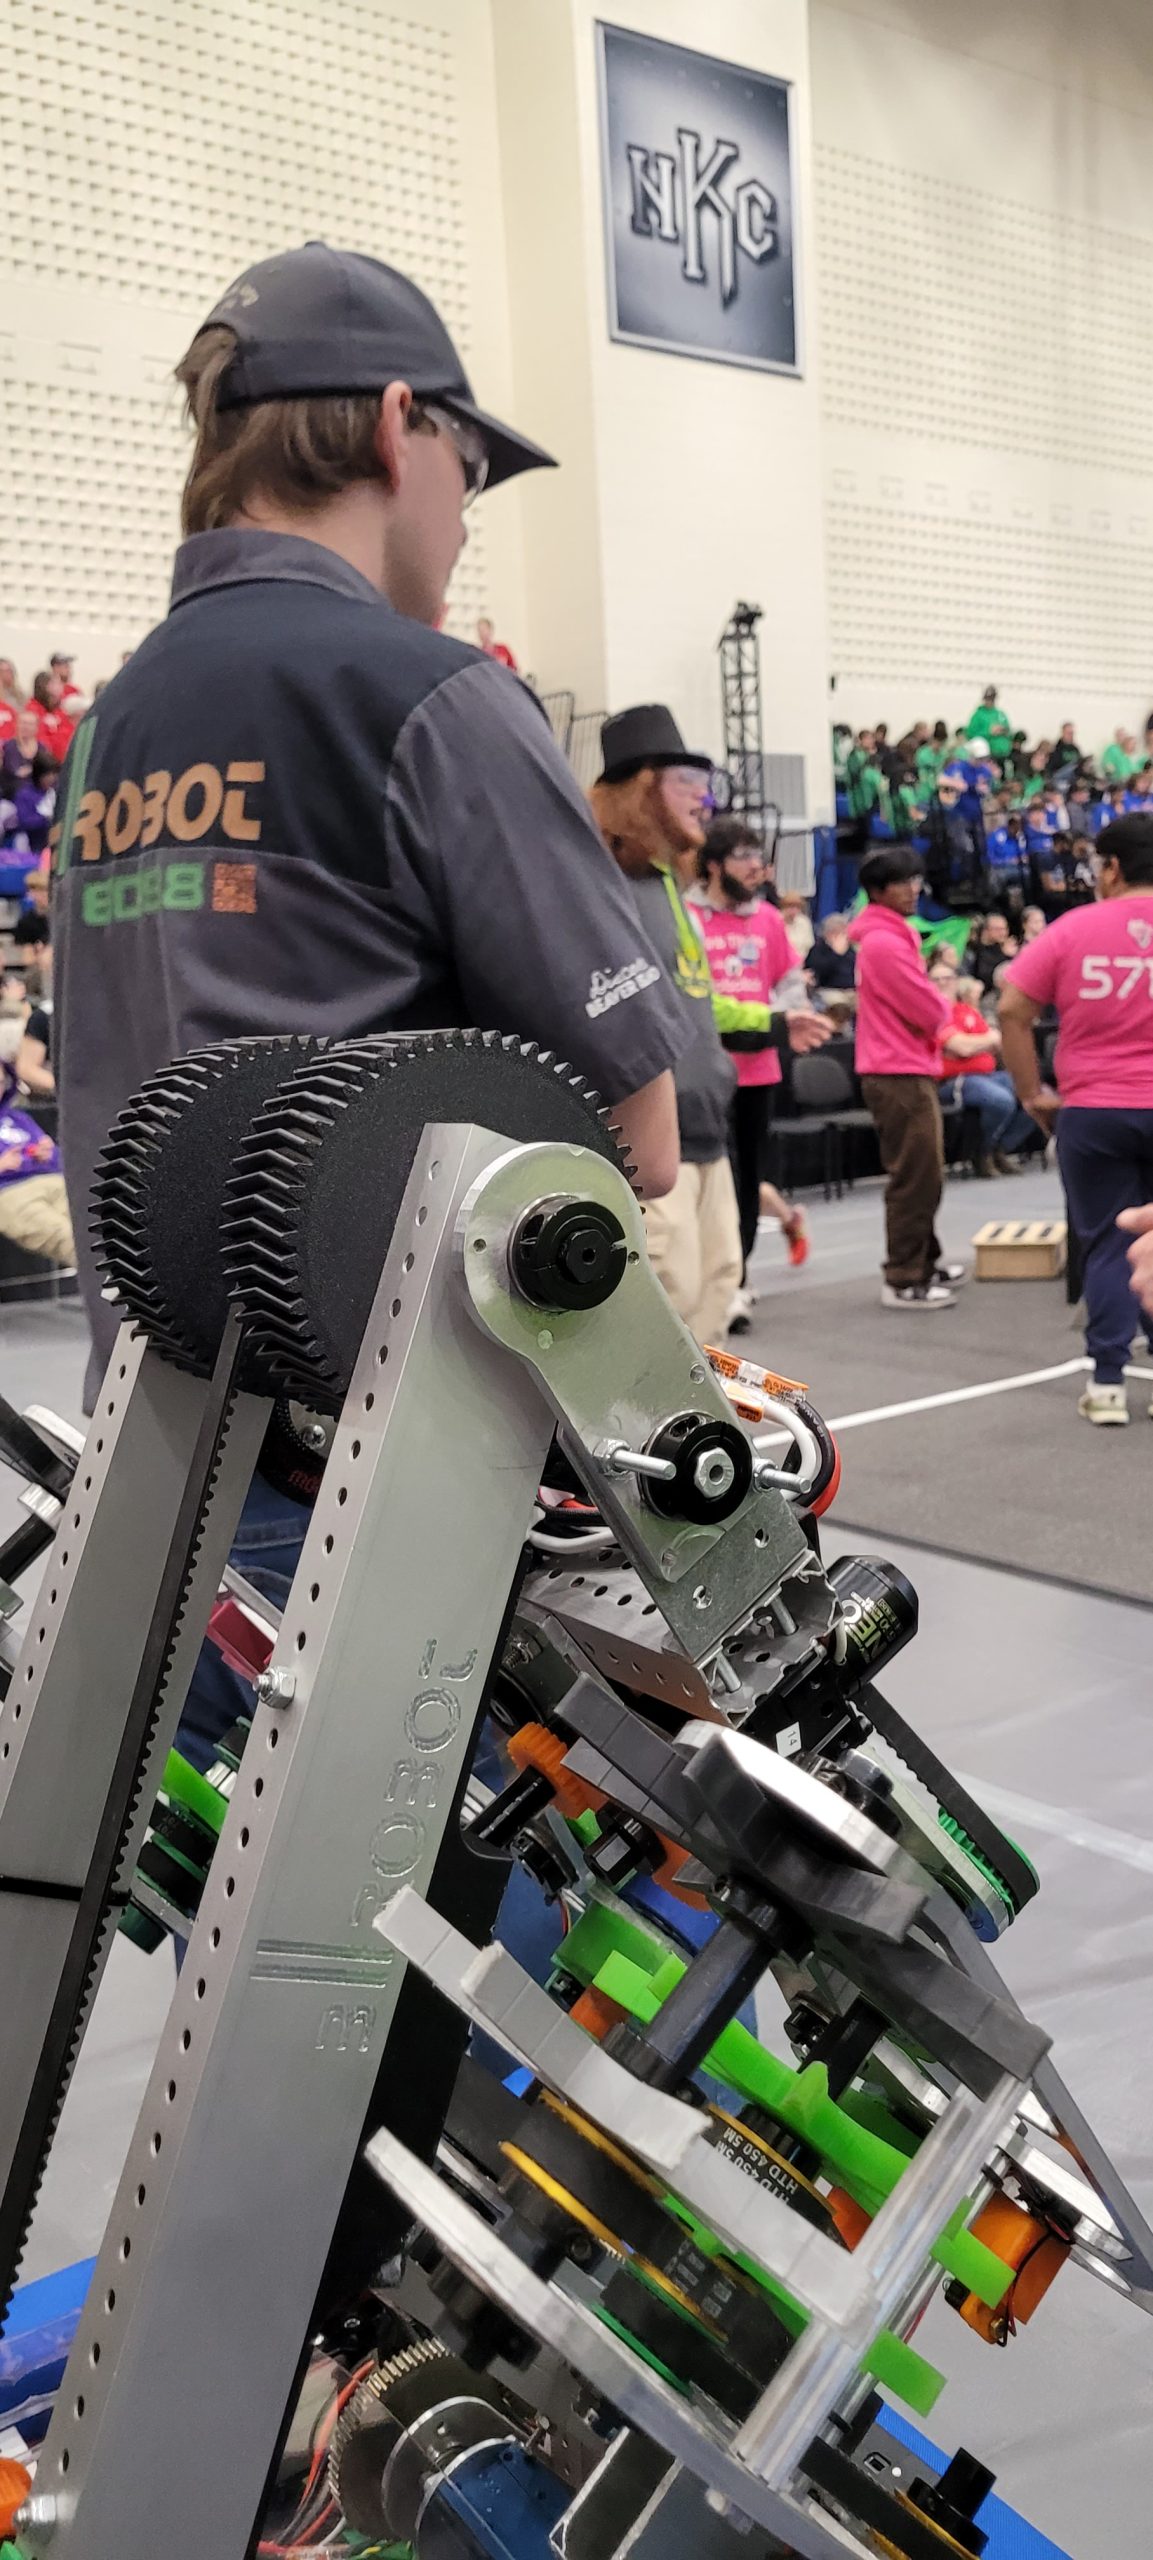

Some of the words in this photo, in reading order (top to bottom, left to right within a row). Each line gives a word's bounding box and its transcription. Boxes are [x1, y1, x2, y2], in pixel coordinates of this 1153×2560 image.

[627, 128, 777, 312] NKC
[787, 1730, 798, 1747] 14
[723, 2127, 744, 2147] 5M
[742, 2143, 768, 2167] 450
[768, 2164, 799, 2195] HTD
